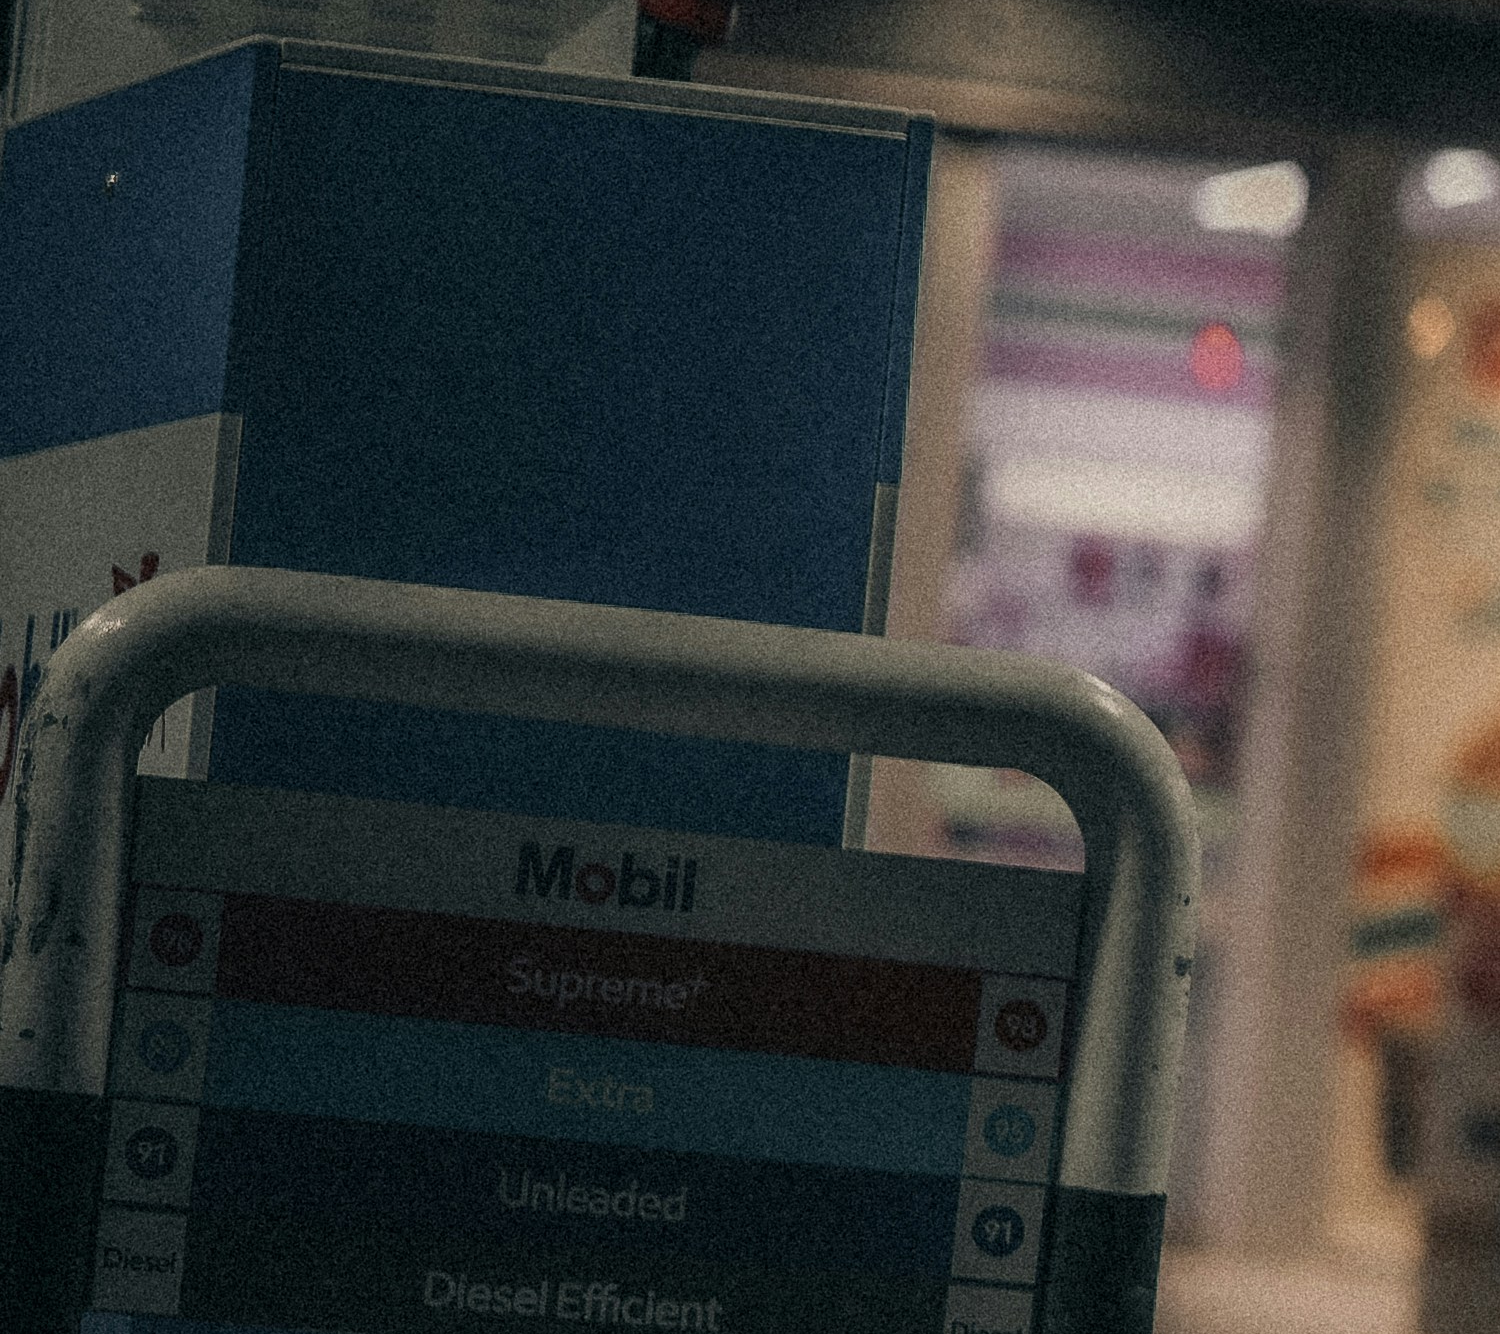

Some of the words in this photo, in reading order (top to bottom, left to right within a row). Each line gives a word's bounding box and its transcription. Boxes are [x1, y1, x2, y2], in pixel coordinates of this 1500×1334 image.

[515, 841, 697, 913] Mobil
[549, 1067, 653, 1114] Extra
[136, 1140, 168, 1167] 91
[501, 1167, 688, 1220] Unleaded
[983, 1218, 1014, 1246] 91
[103, 1245, 179, 1275] Diesel
[424, 1270, 549, 1317] Diesel
[556, 1280, 723, 1332] Efficient
